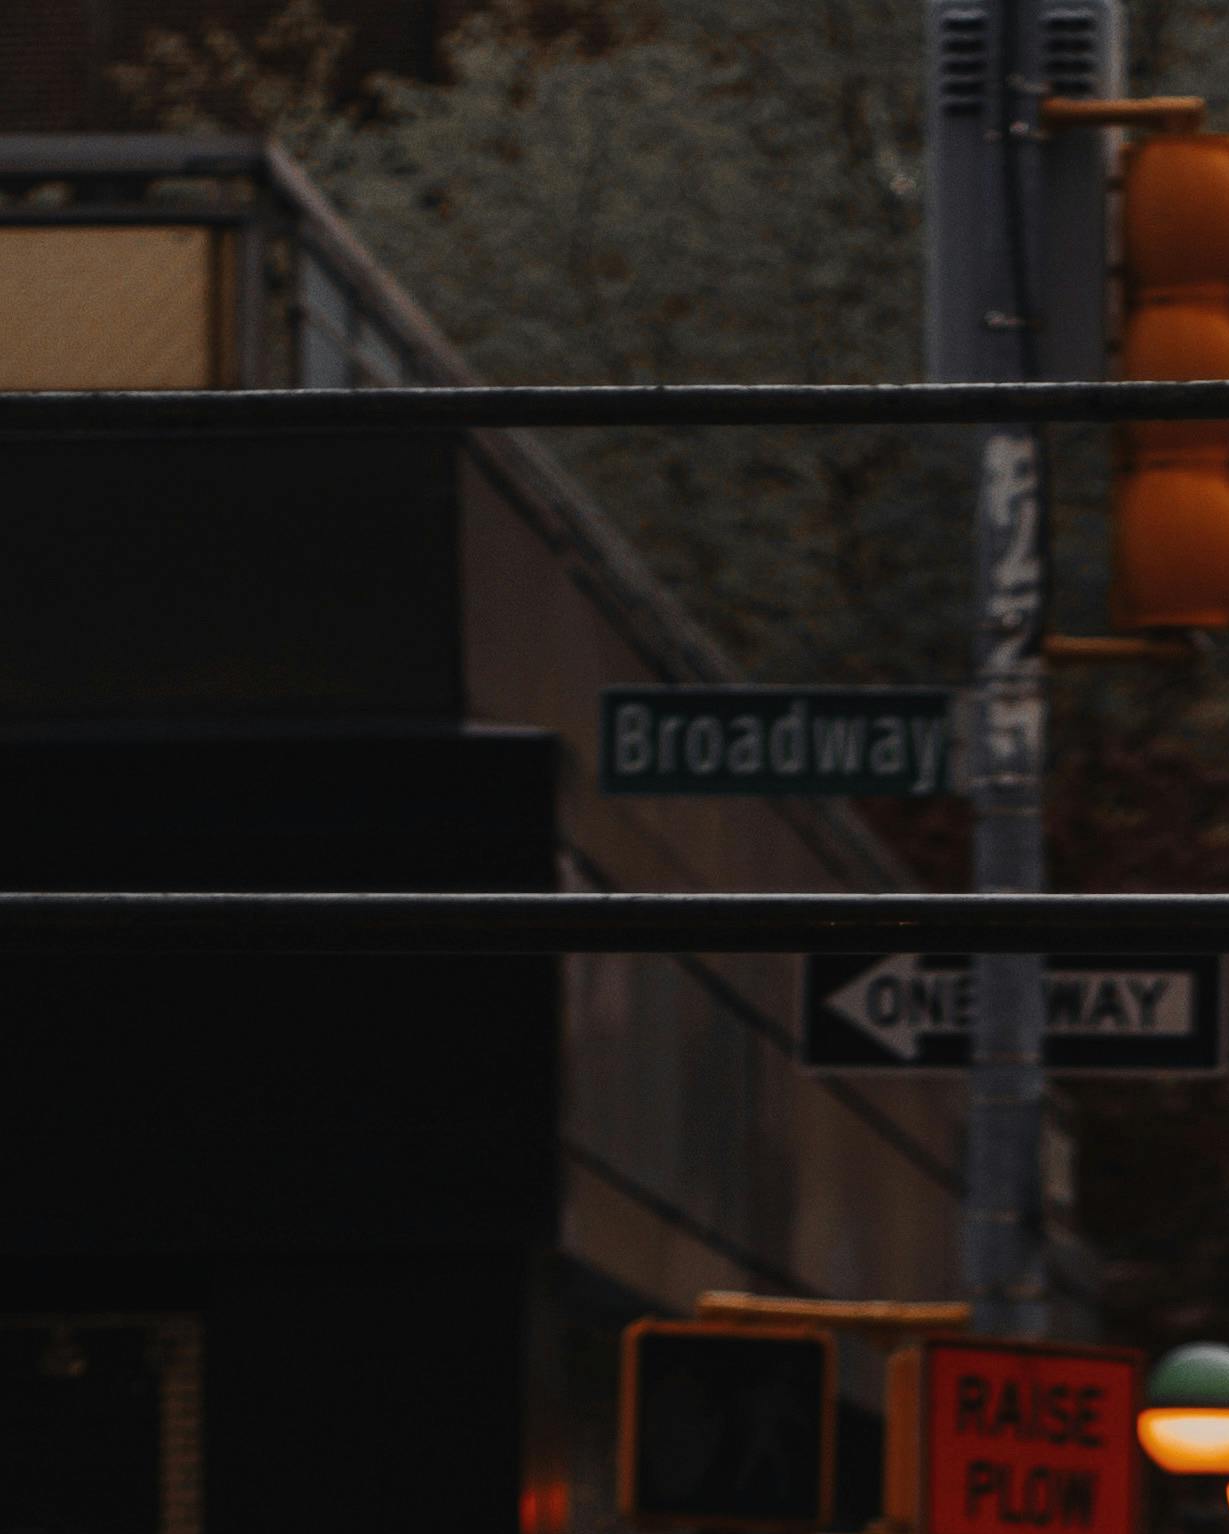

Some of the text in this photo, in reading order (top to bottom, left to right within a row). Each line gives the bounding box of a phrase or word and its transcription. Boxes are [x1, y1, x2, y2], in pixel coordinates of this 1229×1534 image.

[612, 698, 944, 796] Broadway
[864, 974, 1170, 1032] ONE WAY
[956, 1374, 1107, 1448] RAISE
[965, 1460, 1099, 1530] PLOW
